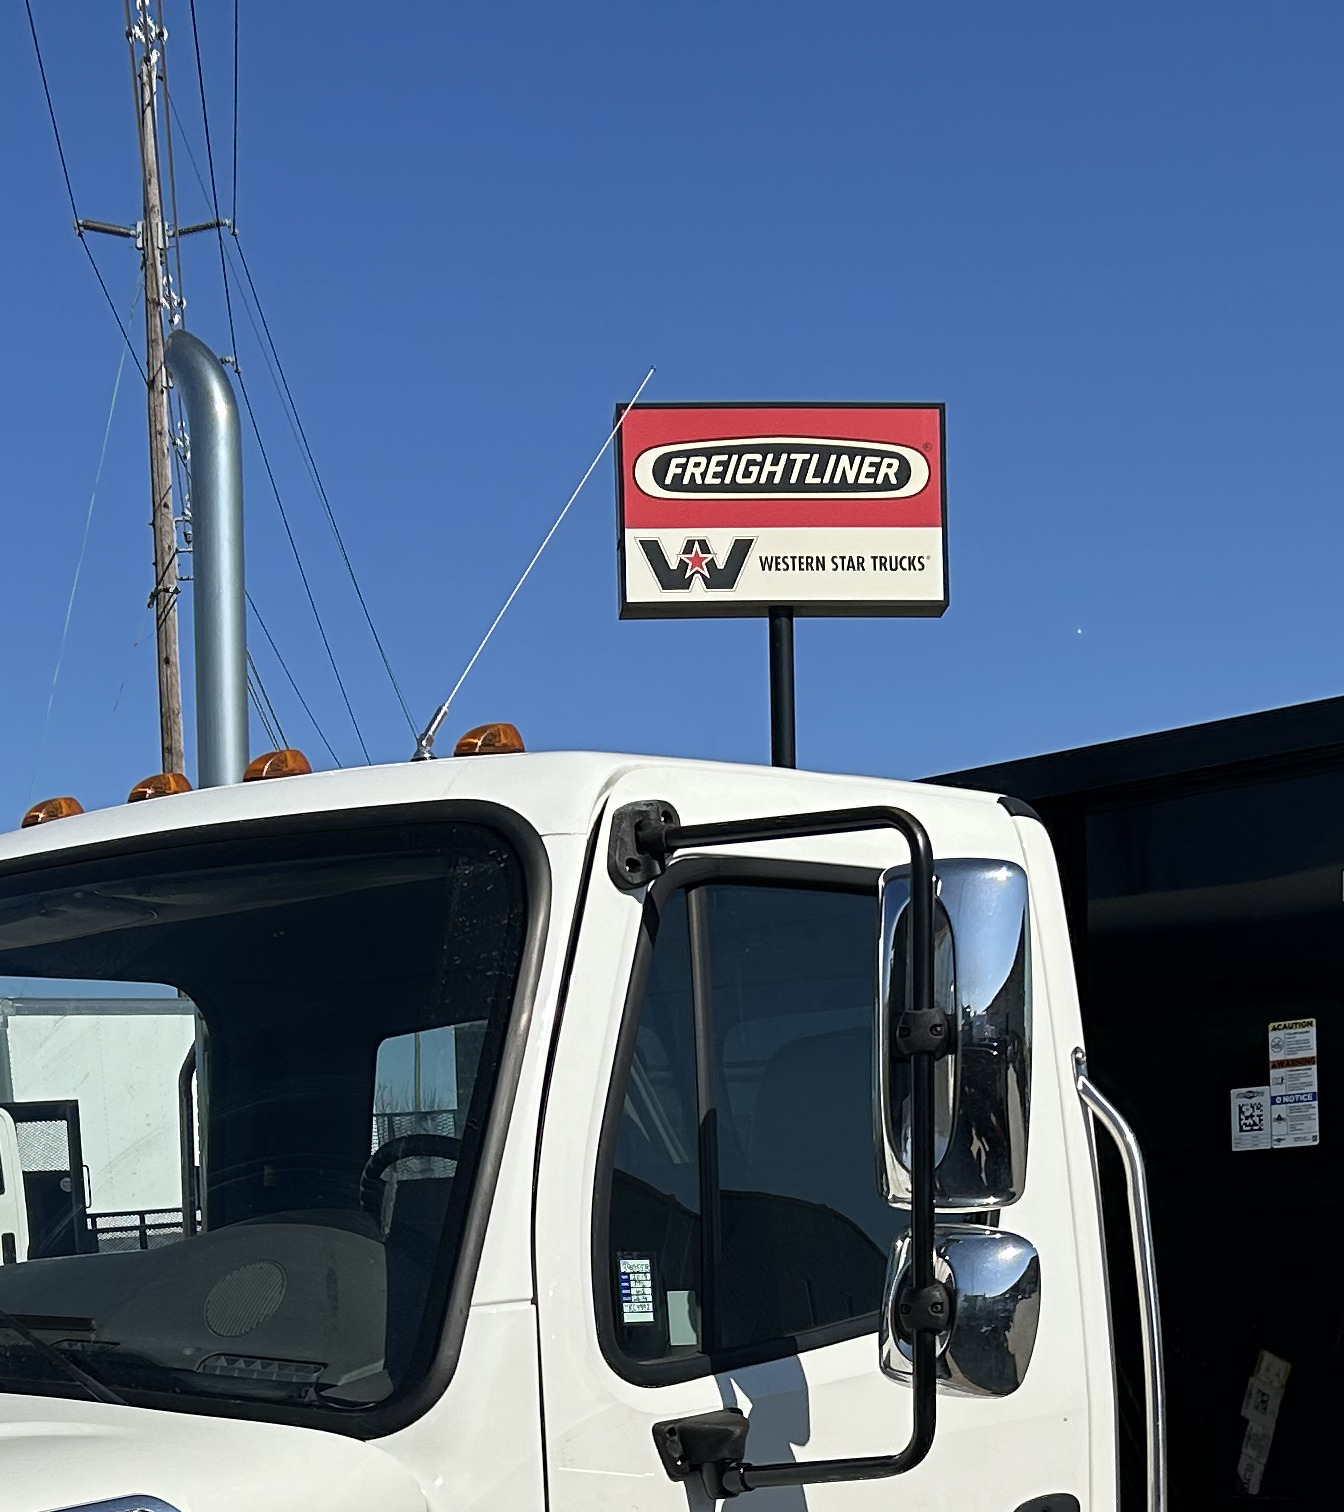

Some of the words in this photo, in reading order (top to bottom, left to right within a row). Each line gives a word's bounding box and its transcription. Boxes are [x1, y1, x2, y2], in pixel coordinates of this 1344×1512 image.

[664, 453, 900, 485] FREIGHTLINER
[759, 555, 825, 572] WESTERN
[832, 555, 866, 572] STAR
[871, 555, 926, 572] TRUCKS
[1277, 1020, 1313, 1030] CAUTION
[1283, 1094, 1312, 1103] NOTICE
